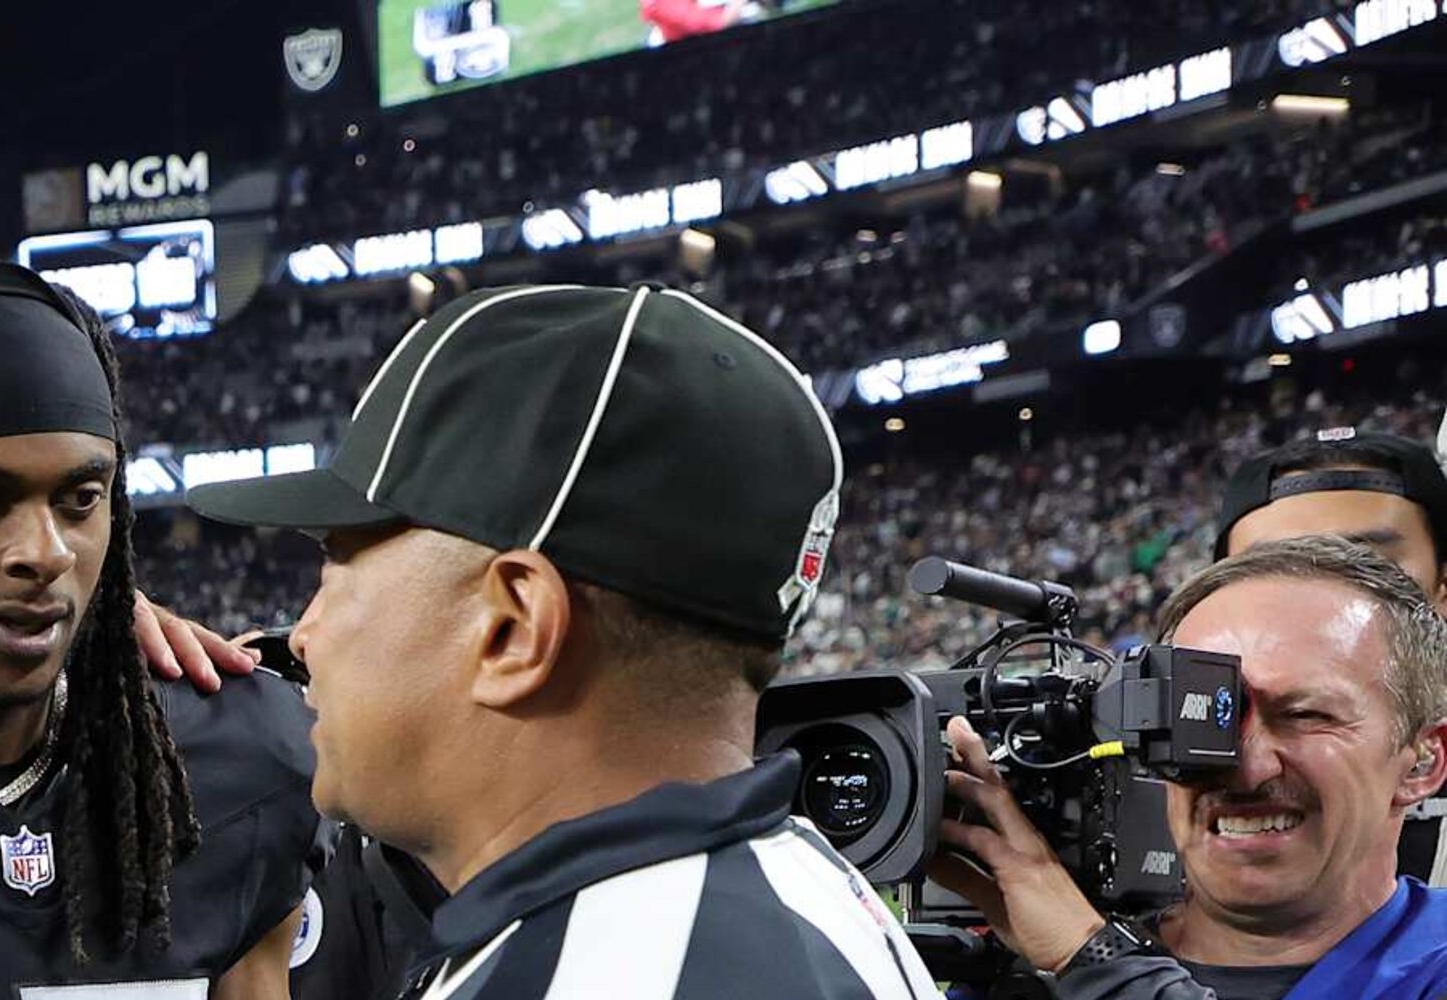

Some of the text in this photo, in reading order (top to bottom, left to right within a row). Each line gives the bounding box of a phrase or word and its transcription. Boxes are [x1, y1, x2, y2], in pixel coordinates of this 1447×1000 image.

[87, 151, 209, 203] MGM
[1180, 693, 1209, 721] ARRI
[12, 857, 49, 883] NFL
[1141, 851, 1171, 875] ARRI
